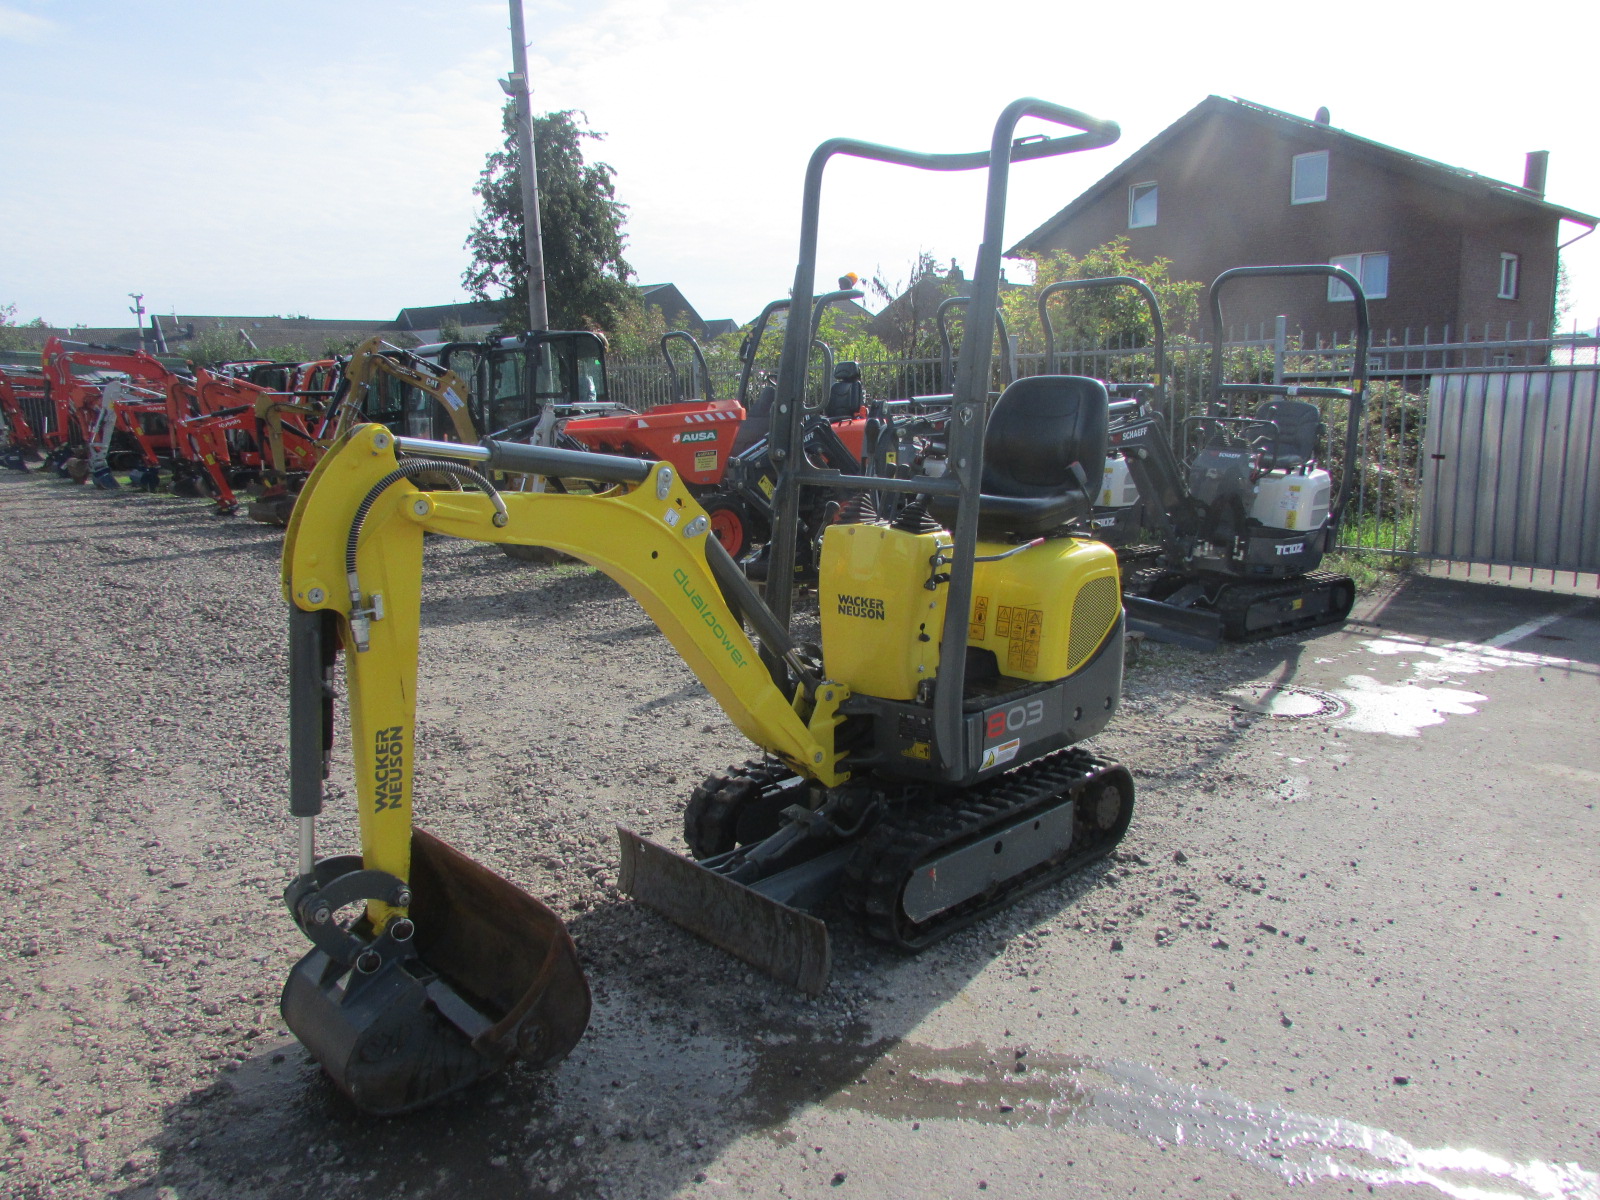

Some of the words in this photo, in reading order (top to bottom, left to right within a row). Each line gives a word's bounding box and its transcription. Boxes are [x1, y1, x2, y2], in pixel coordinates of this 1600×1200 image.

[425, 378, 439, 389] CAT
[218, 419, 242, 428] Kubota
[681, 431, 716, 442] AUSA
[1122, 427, 1148, 440] SCHAEFF
[837, 593, 885, 610] WACKER
[673, 568, 748, 668] dualpower
[837, 604, 885, 621] NEUSON
[986, 699, 1044, 738] 803
[374, 727, 389, 814] WACKER
[388, 725, 404, 809] NEUSON
